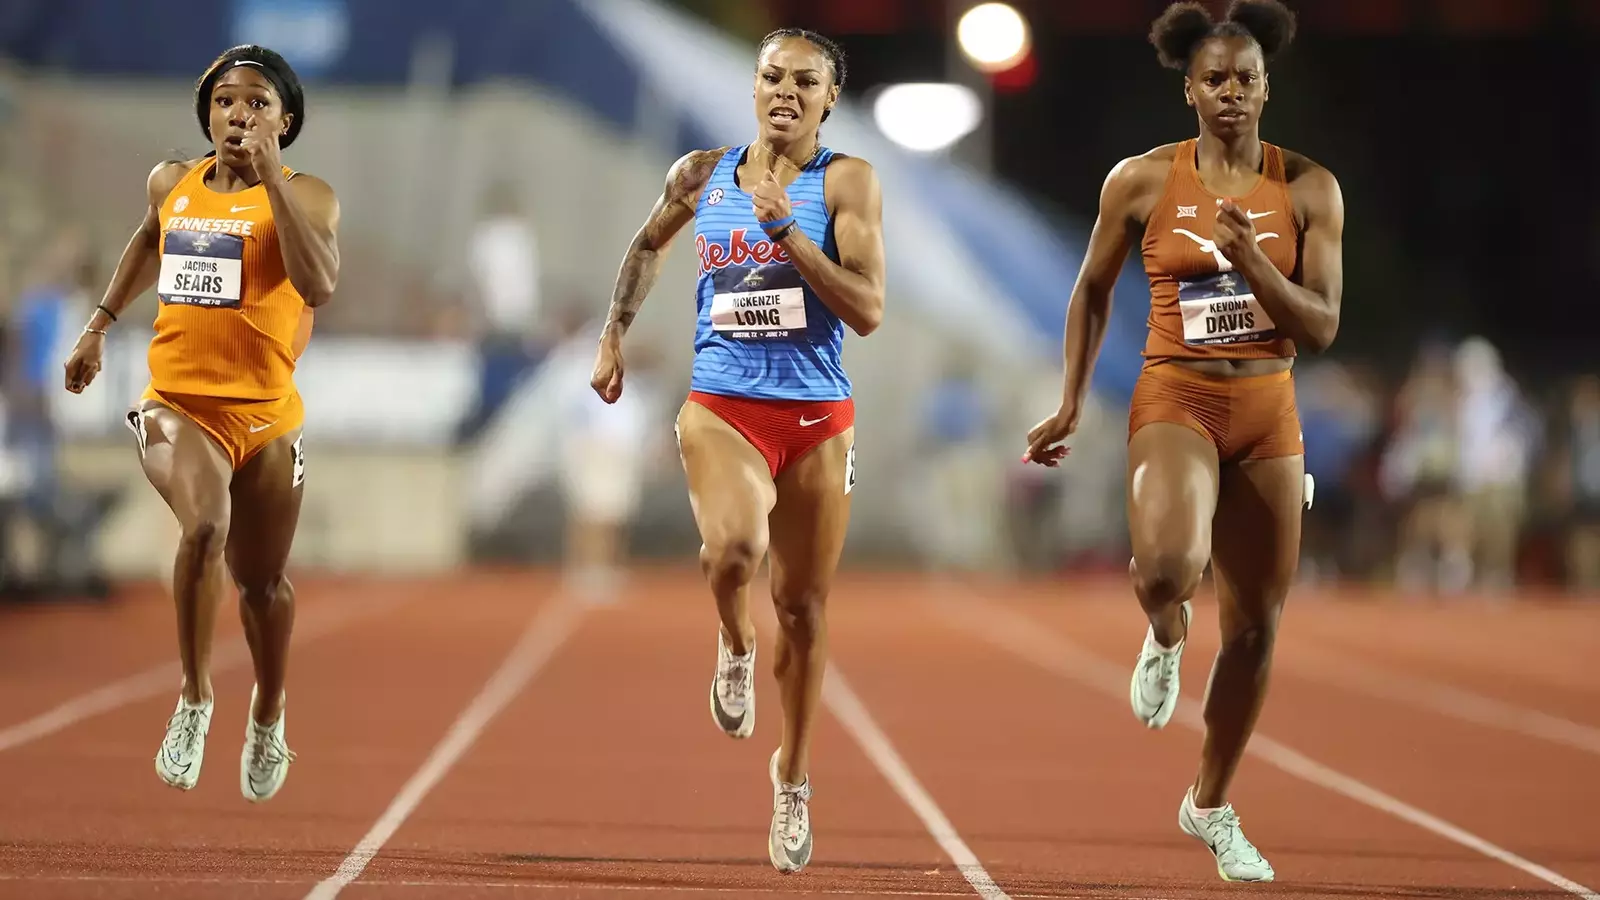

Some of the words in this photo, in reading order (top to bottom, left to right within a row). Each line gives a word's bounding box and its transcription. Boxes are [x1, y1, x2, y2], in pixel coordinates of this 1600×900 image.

[165, 216, 255, 236] TENNESSEE
[182, 260, 218, 273] JACIOUS
[174, 273, 223, 294] SEARS
[732, 294, 781, 308] MCKENZIE
[1209, 299, 1249, 313] KEVONA
[735, 309, 781, 326] LONG
[1205, 311, 1255, 334] DAVIS
